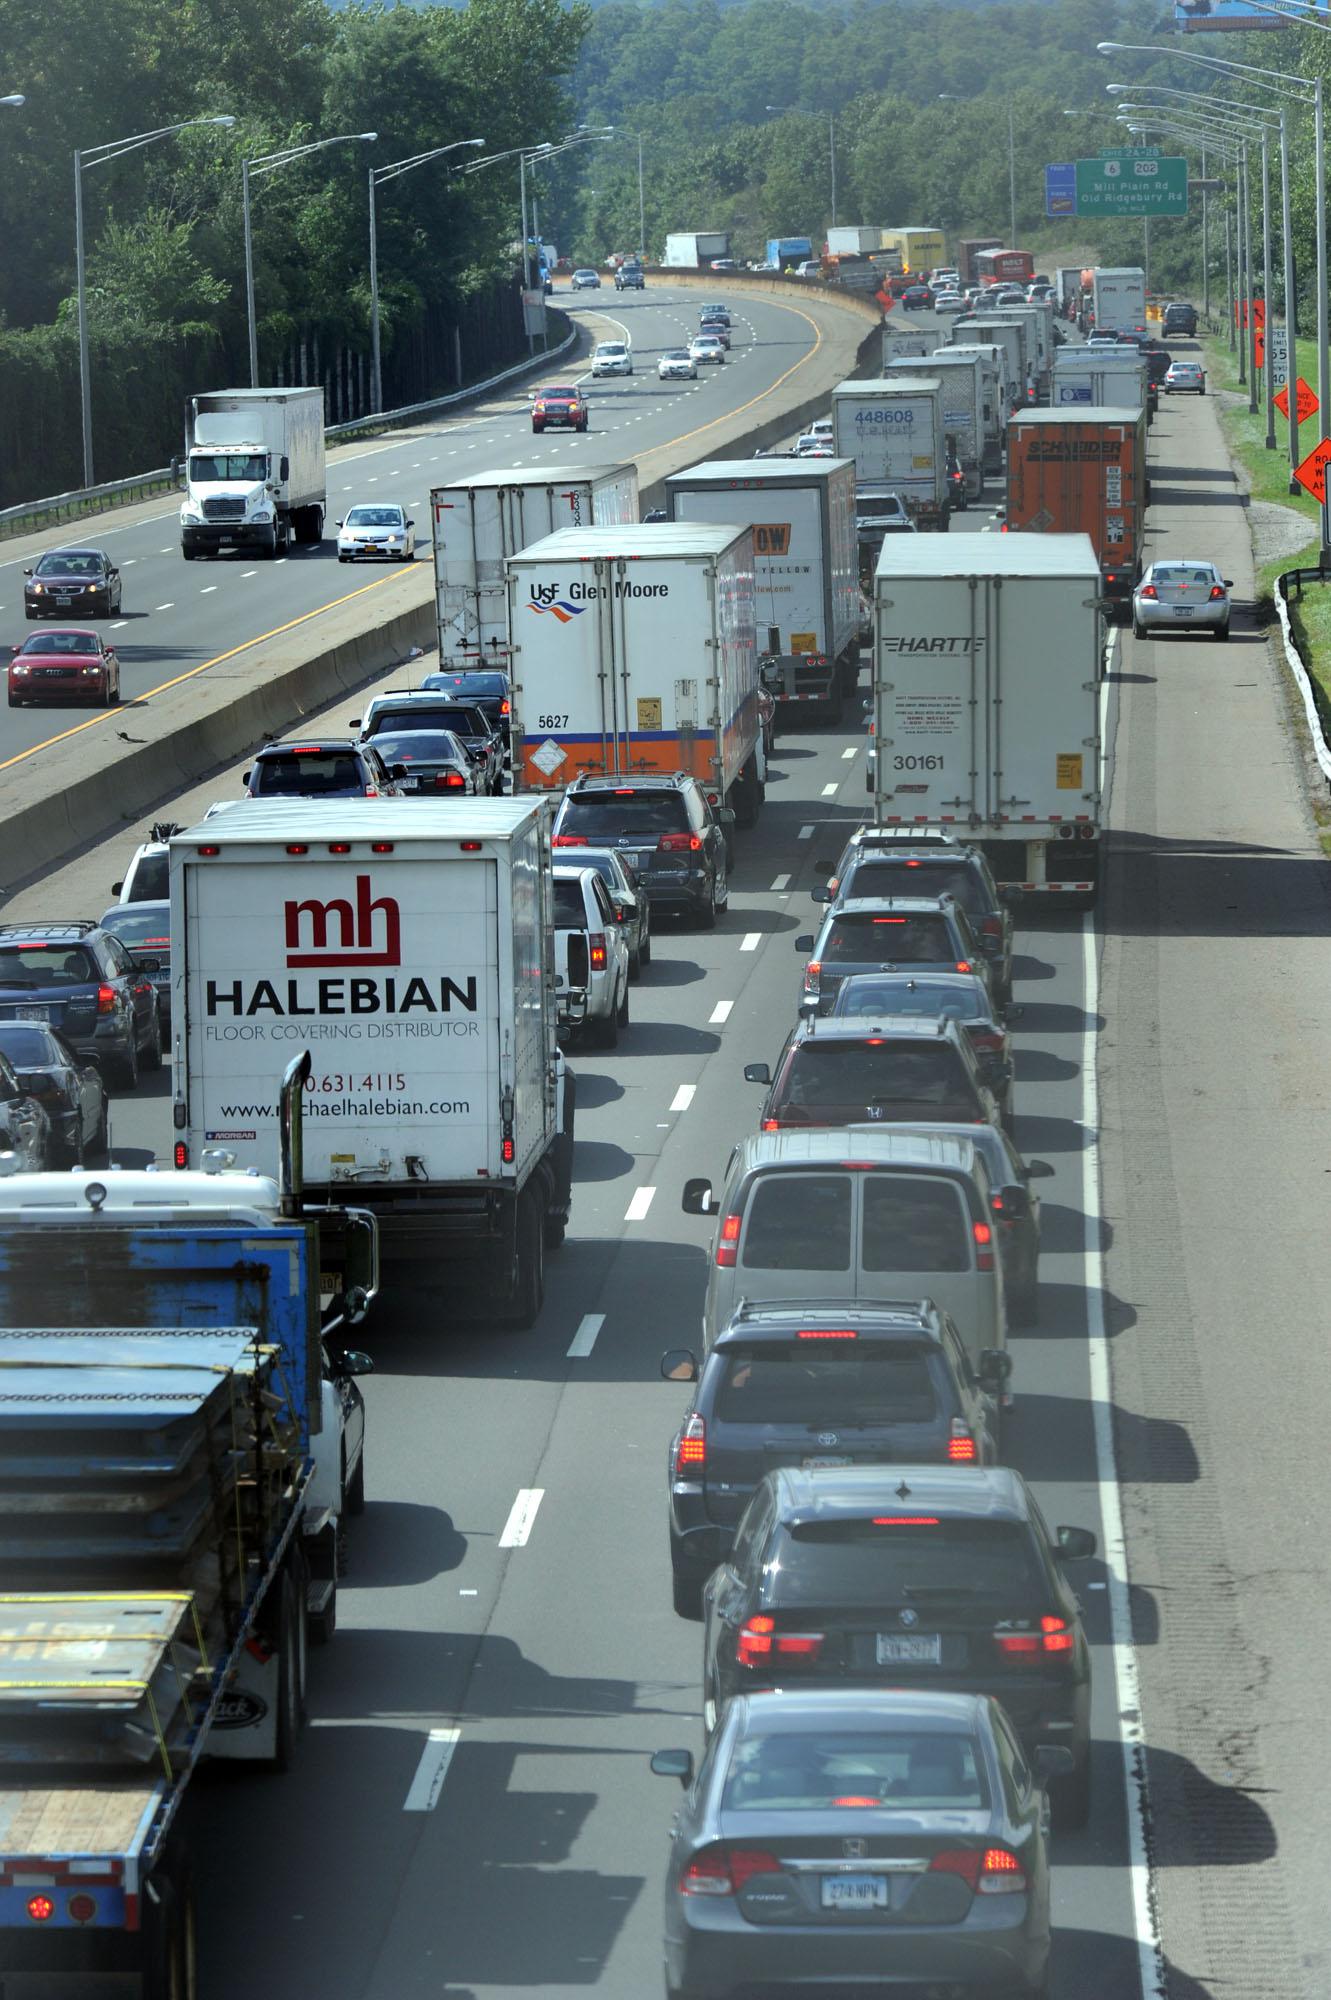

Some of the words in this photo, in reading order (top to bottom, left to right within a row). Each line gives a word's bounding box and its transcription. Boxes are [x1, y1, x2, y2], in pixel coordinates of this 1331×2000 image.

[1109, 164, 1116, 173] 6
[1135, 163, 1157, 173] 202
[1094, 183, 1115, 191] Mill
[1155, 182, 1169, 190] Rd
[1081, 194, 1100, 202] Old
[1104, 193, 1163, 203] Ridgebury
[1168, 193, 1183, 201] Rd
[855, 410, 914, 424] 448608
[1028, 441, 1121, 453] SCHNEIDER
[1315, 455, 1328, 464] RO
[756, 527, 786, 551] OW
[761, 566, 810, 574] YELLOW
[530, 583, 560, 604] USF
[569, 582, 607, 600] Glen
[615, 581, 669, 598] Moore
[538, 715, 569, 728] 5627
[893, 755, 944, 770] 30161
[206, 976, 477, 1016] HALEBIAN
[206, 1025, 265, 1041] FLOOR
[270, 1024, 362, 1040] COVERING
[367, 1021, 480, 1039] DISTRIBUTOR
[306, 1073, 406, 1093] 0.631.4115
[220, 1099, 471, 1119] www.chaelhalebian.com
[214, 1698, 252, 1717] ack
